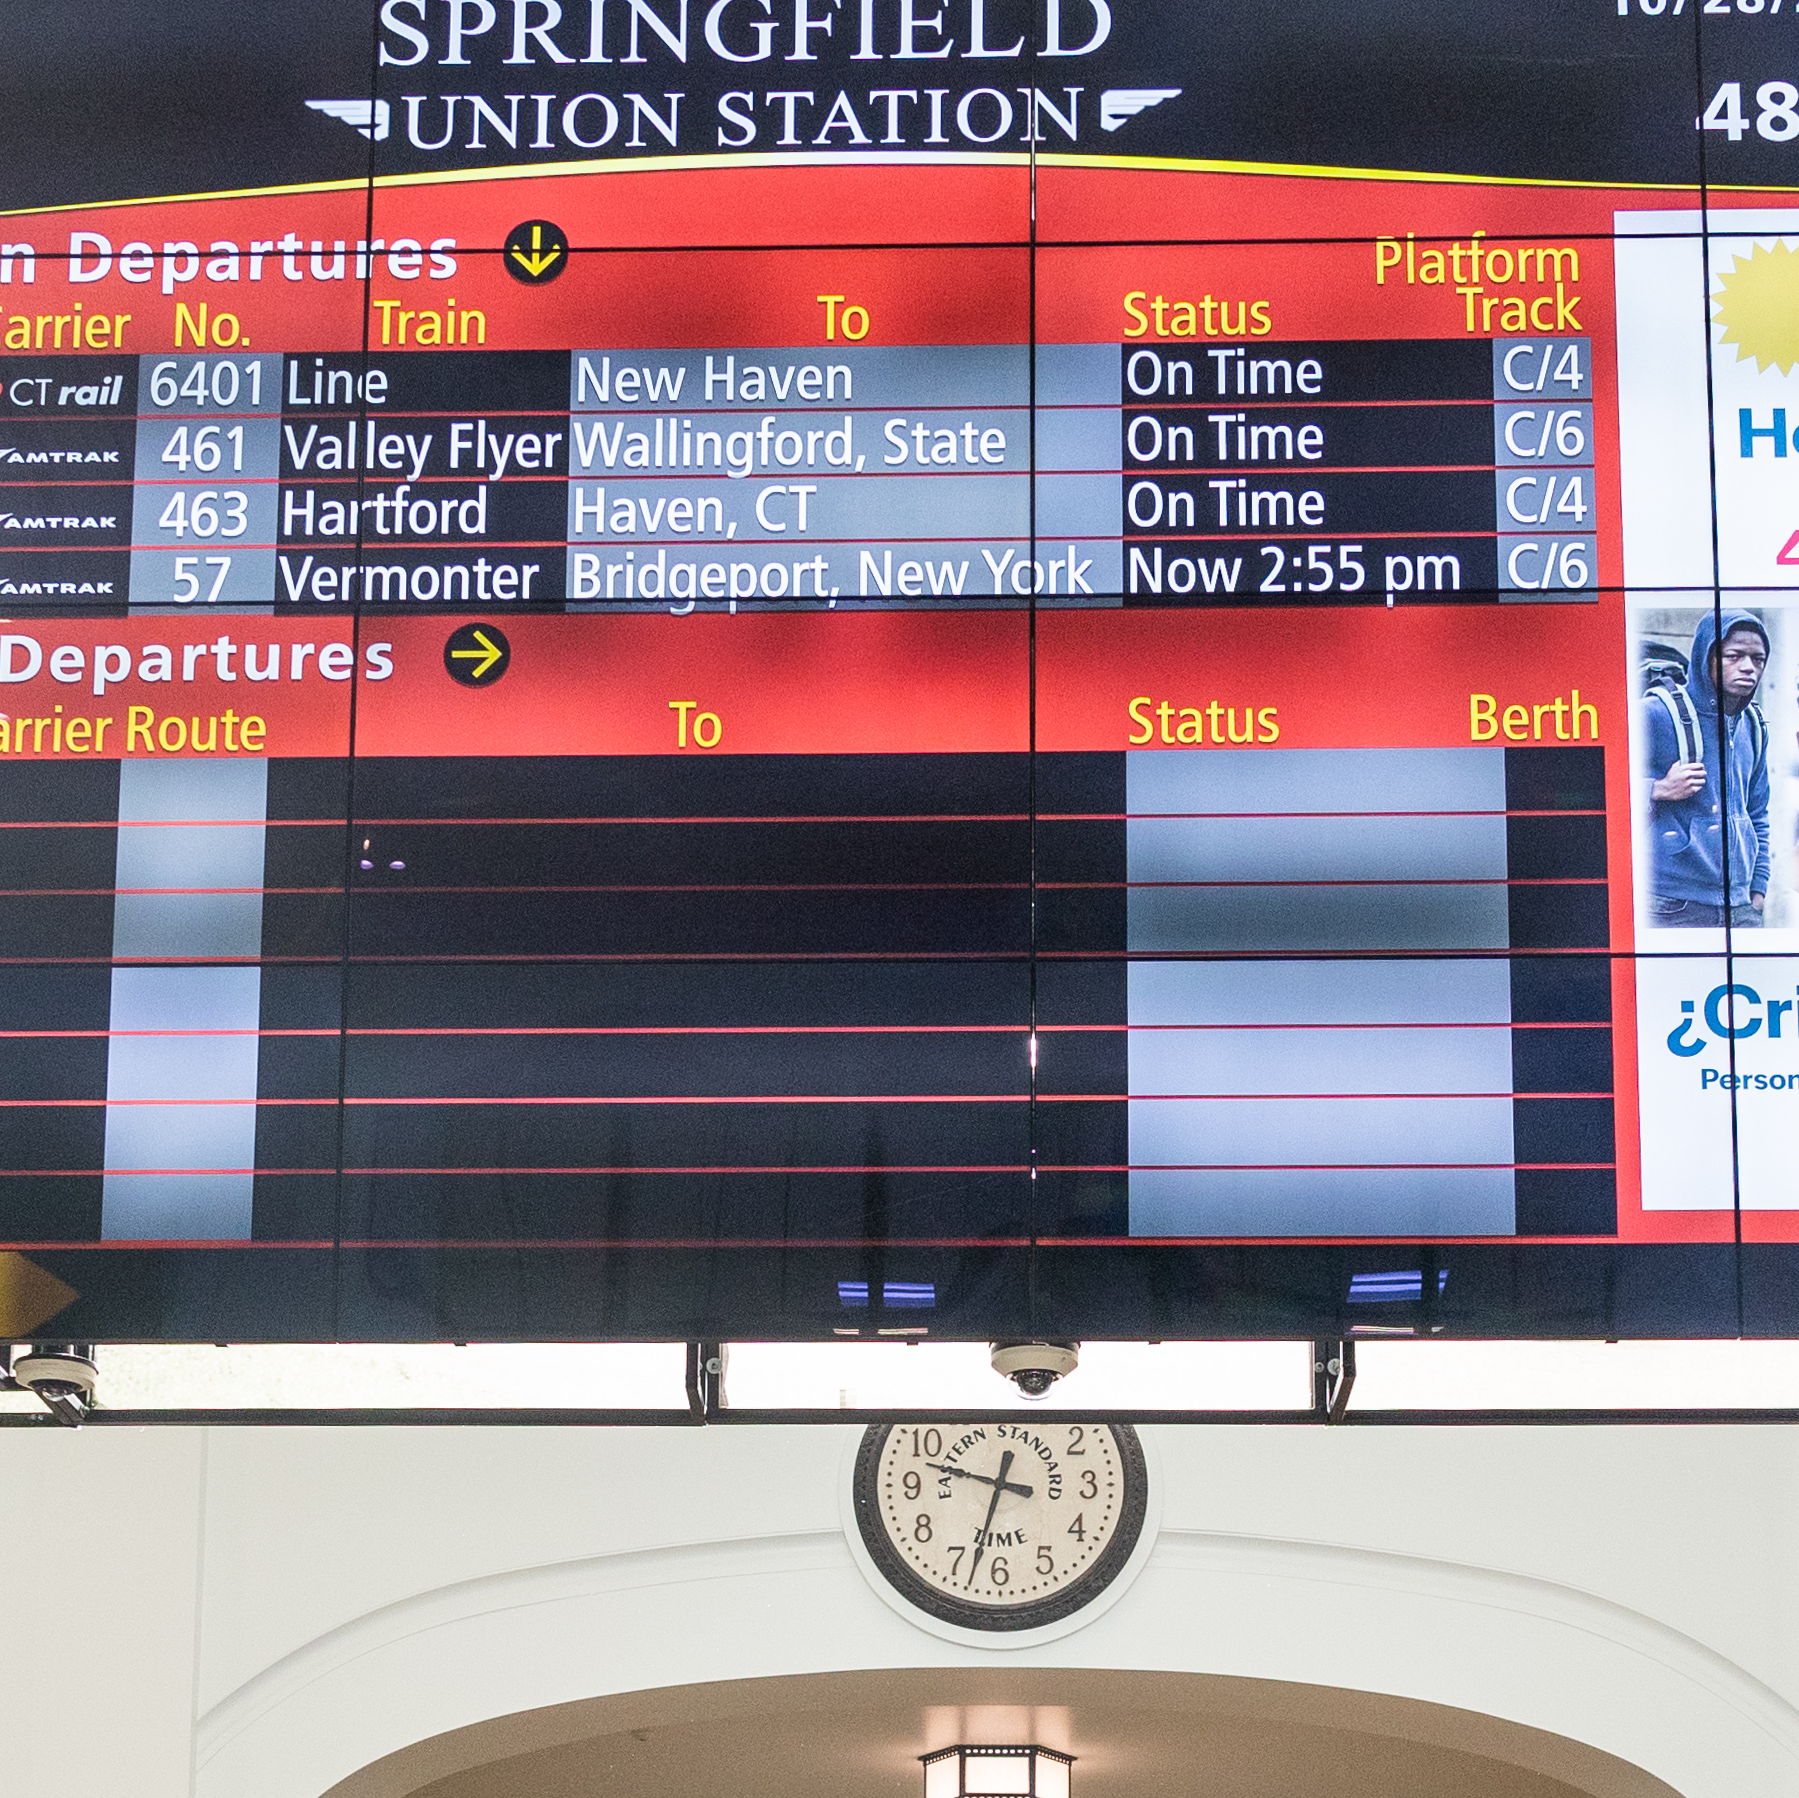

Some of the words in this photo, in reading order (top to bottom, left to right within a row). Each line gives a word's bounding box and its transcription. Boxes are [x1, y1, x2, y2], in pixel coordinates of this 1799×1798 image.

[380, 0, 1111, 66] SPRINGFIELD
[402, 94, 685, 149] UNION
[718, 88, 1084, 146] STATION
[69, 233, 456, 294] Departures
[1376, 231, 1578, 291] Platform
[175, 302, 250, 346] No.
[373, 298, 485, 344] Train
[817, 295, 869, 339] To
[1124, 291, 1271, 336] Status
[1456, 282, 1582, 331] Track
[151, 361, 260, 406] 6401
[290, 359, 387, 404] Line
[578, 357, 685, 401] New
[705, 356, 851, 400] Haven
[1128, 351, 1192, 395] On
[1208, 348, 1322, 394] Time
[1504, 345, 1583, 390] C/4
[3, 448, 118, 463] AMTRAK
[162, 426, 243, 470] 461
[285, 421, 432, 481] Valley
[450, 420, 562, 481] Flyer
[574, 416, 865, 478] Wallingford,
[884, 419, 1005, 464] State
[1128, 416, 1193, 461] On
[1208, 414, 1323, 460] Time
[1505, 411, 1584, 456] C/6
[0, 513, 116, 528] AMTRAK
[159, 491, 247, 536] 463
[284, 485, 486, 535] Hartford
[575, 488, 737, 538] Haven,
[756, 485, 817, 531] CT
[1128, 481, 1194, 527] On
[1209, 479, 1324, 526] Time
[1507, 477, 1587, 522] C/4
[174, 557, 231, 602] 57
[279, 556, 539, 601] Vermonter
[573, 549, 839, 614] Bridgeport,
[860, 551, 969, 595] New
[981, 544, 1096, 600] York
[1130, 548, 1242, 593] Now
[1260, 546, 1364, 591] 2:55
[1386, 556, 1459, 607] pm
[1508, 543, 1588, 588] C/6
[0, 635, 393, 695] Departures
[127, 706, 266, 751] Route
[669, 701, 722, 747] To
[1129, 697, 1279, 743] Status
[1470, 690, 1598, 740] Berth
[913, 1429, 942, 1457] 10
[997, 1424, 1063, 1501] STANDARD
[1067, 1427, 1085, 1455] 2
[903, 1471, 921, 1500] 9
[1080, 1470, 1097, 1499] 3
[914, 1514, 932, 1543] 8
[973, 1527, 1028, 1547] TIME
[1068, 1513, 1086, 1542] 4
[945, 1546, 966, 1576] 7
[991, 1557, 1009, 1586] 6
[1035, 1545, 1054, 1576] 5
